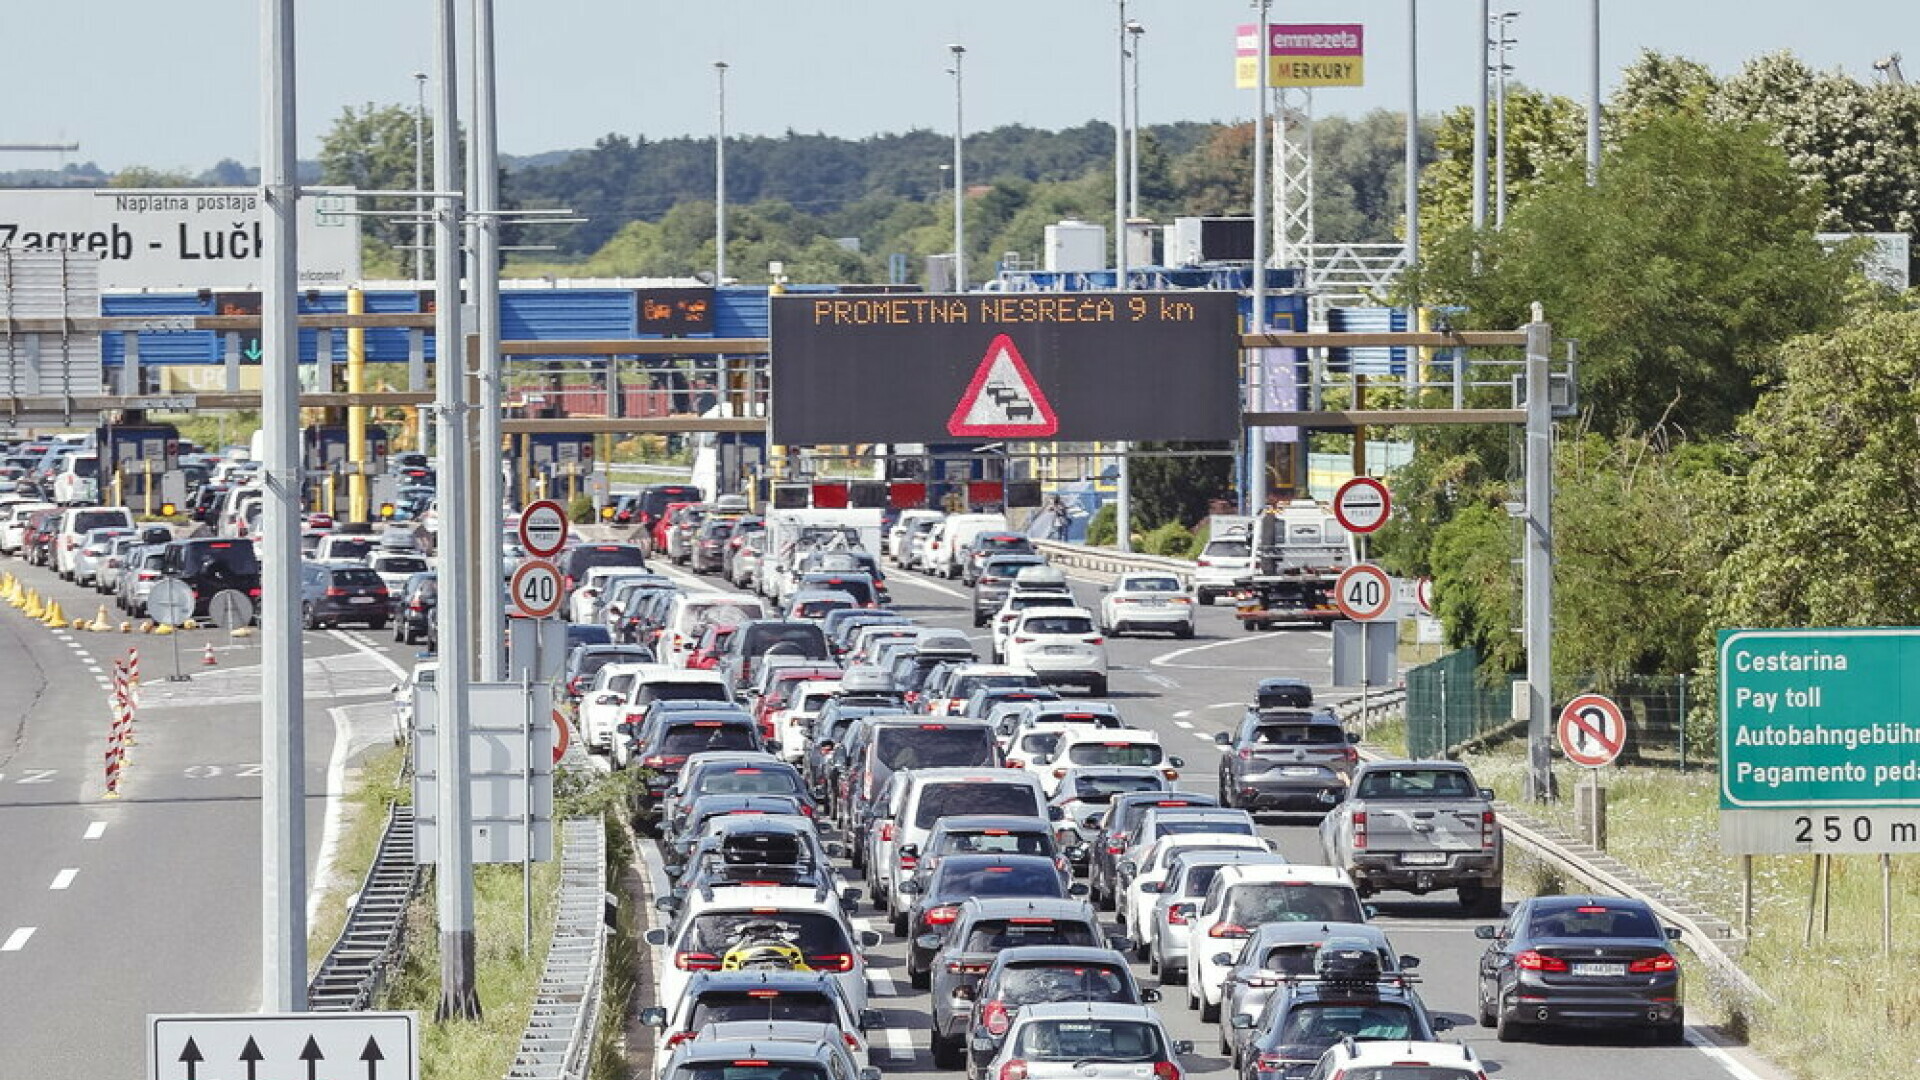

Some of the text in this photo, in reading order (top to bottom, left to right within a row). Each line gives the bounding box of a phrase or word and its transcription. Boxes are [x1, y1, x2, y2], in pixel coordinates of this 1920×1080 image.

[1273, 31, 1358, 49] emmezeta
[1279, 62, 1353, 79] MERKURY
[117, 194, 256, 213] Naplatna postaja
[815, 299, 968, 324] PROMETNA
[1129, 297, 1147, 322] 9
[1161, 297, 1195, 322] km
[524, 576, 552, 601] 40
[1348, 581, 1379, 606] 40
[1735, 650, 1847, 672] Cestarina
[1736, 686, 1821, 713] Pay toll
[1737, 759, 1920, 788] Pagamento ped
[1890, 822, 1917, 842] m
